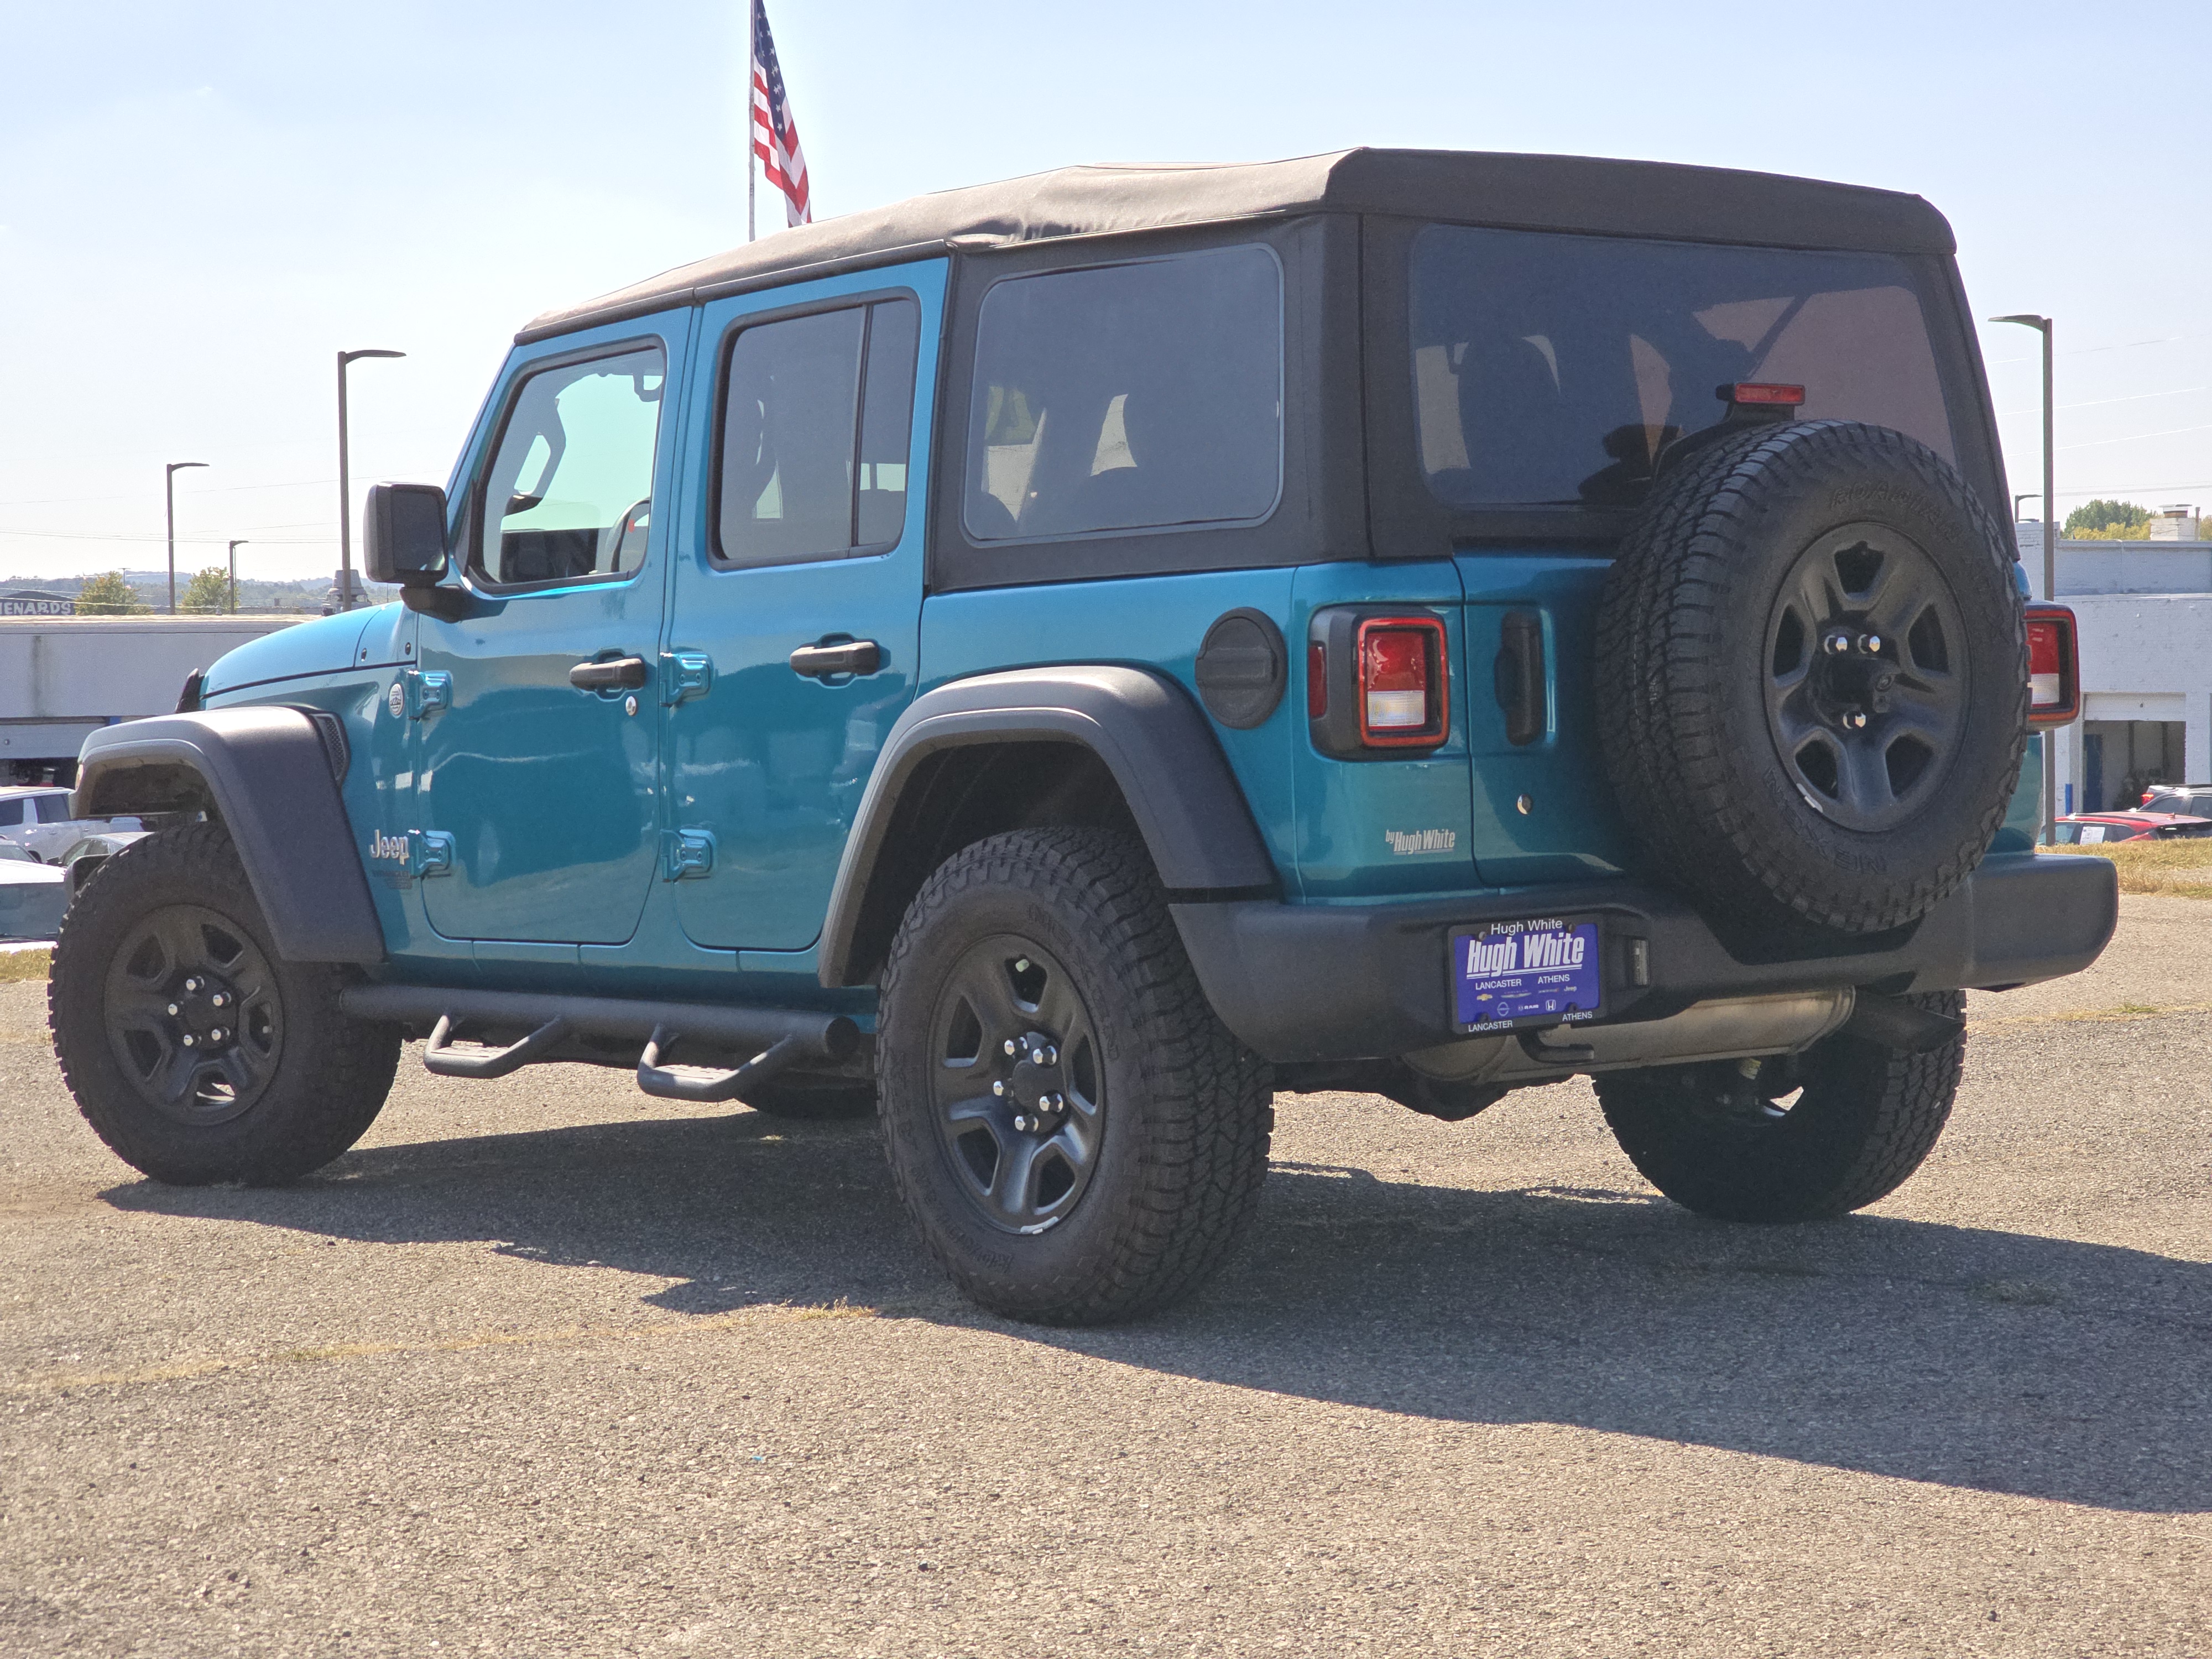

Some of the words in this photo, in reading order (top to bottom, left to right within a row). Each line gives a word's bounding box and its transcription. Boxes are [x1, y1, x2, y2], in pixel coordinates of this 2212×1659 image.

[0, 602, 71, 615] ENARDS
[369, 829, 410, 865] Jeep
[1385, 830, 1395, 844] by
[1394, 831, 1421, 854] Hugh
[1423, 829, 1455, 849] White
[1490, 921, 1524, 936] Hugh
[1527, 919, 1563, 931] White
[1467, 936, 1517, 977] Hugh
[1524, 932, 1585, 968] White
[1475, 978, 1522, 990] LANCASTER
[1538, 974, 1571, 984] ATHENS
[1468, 1020, 1513, 1032] LANCASTER
[1562, 1011, 1593, 1022] ATHENS
